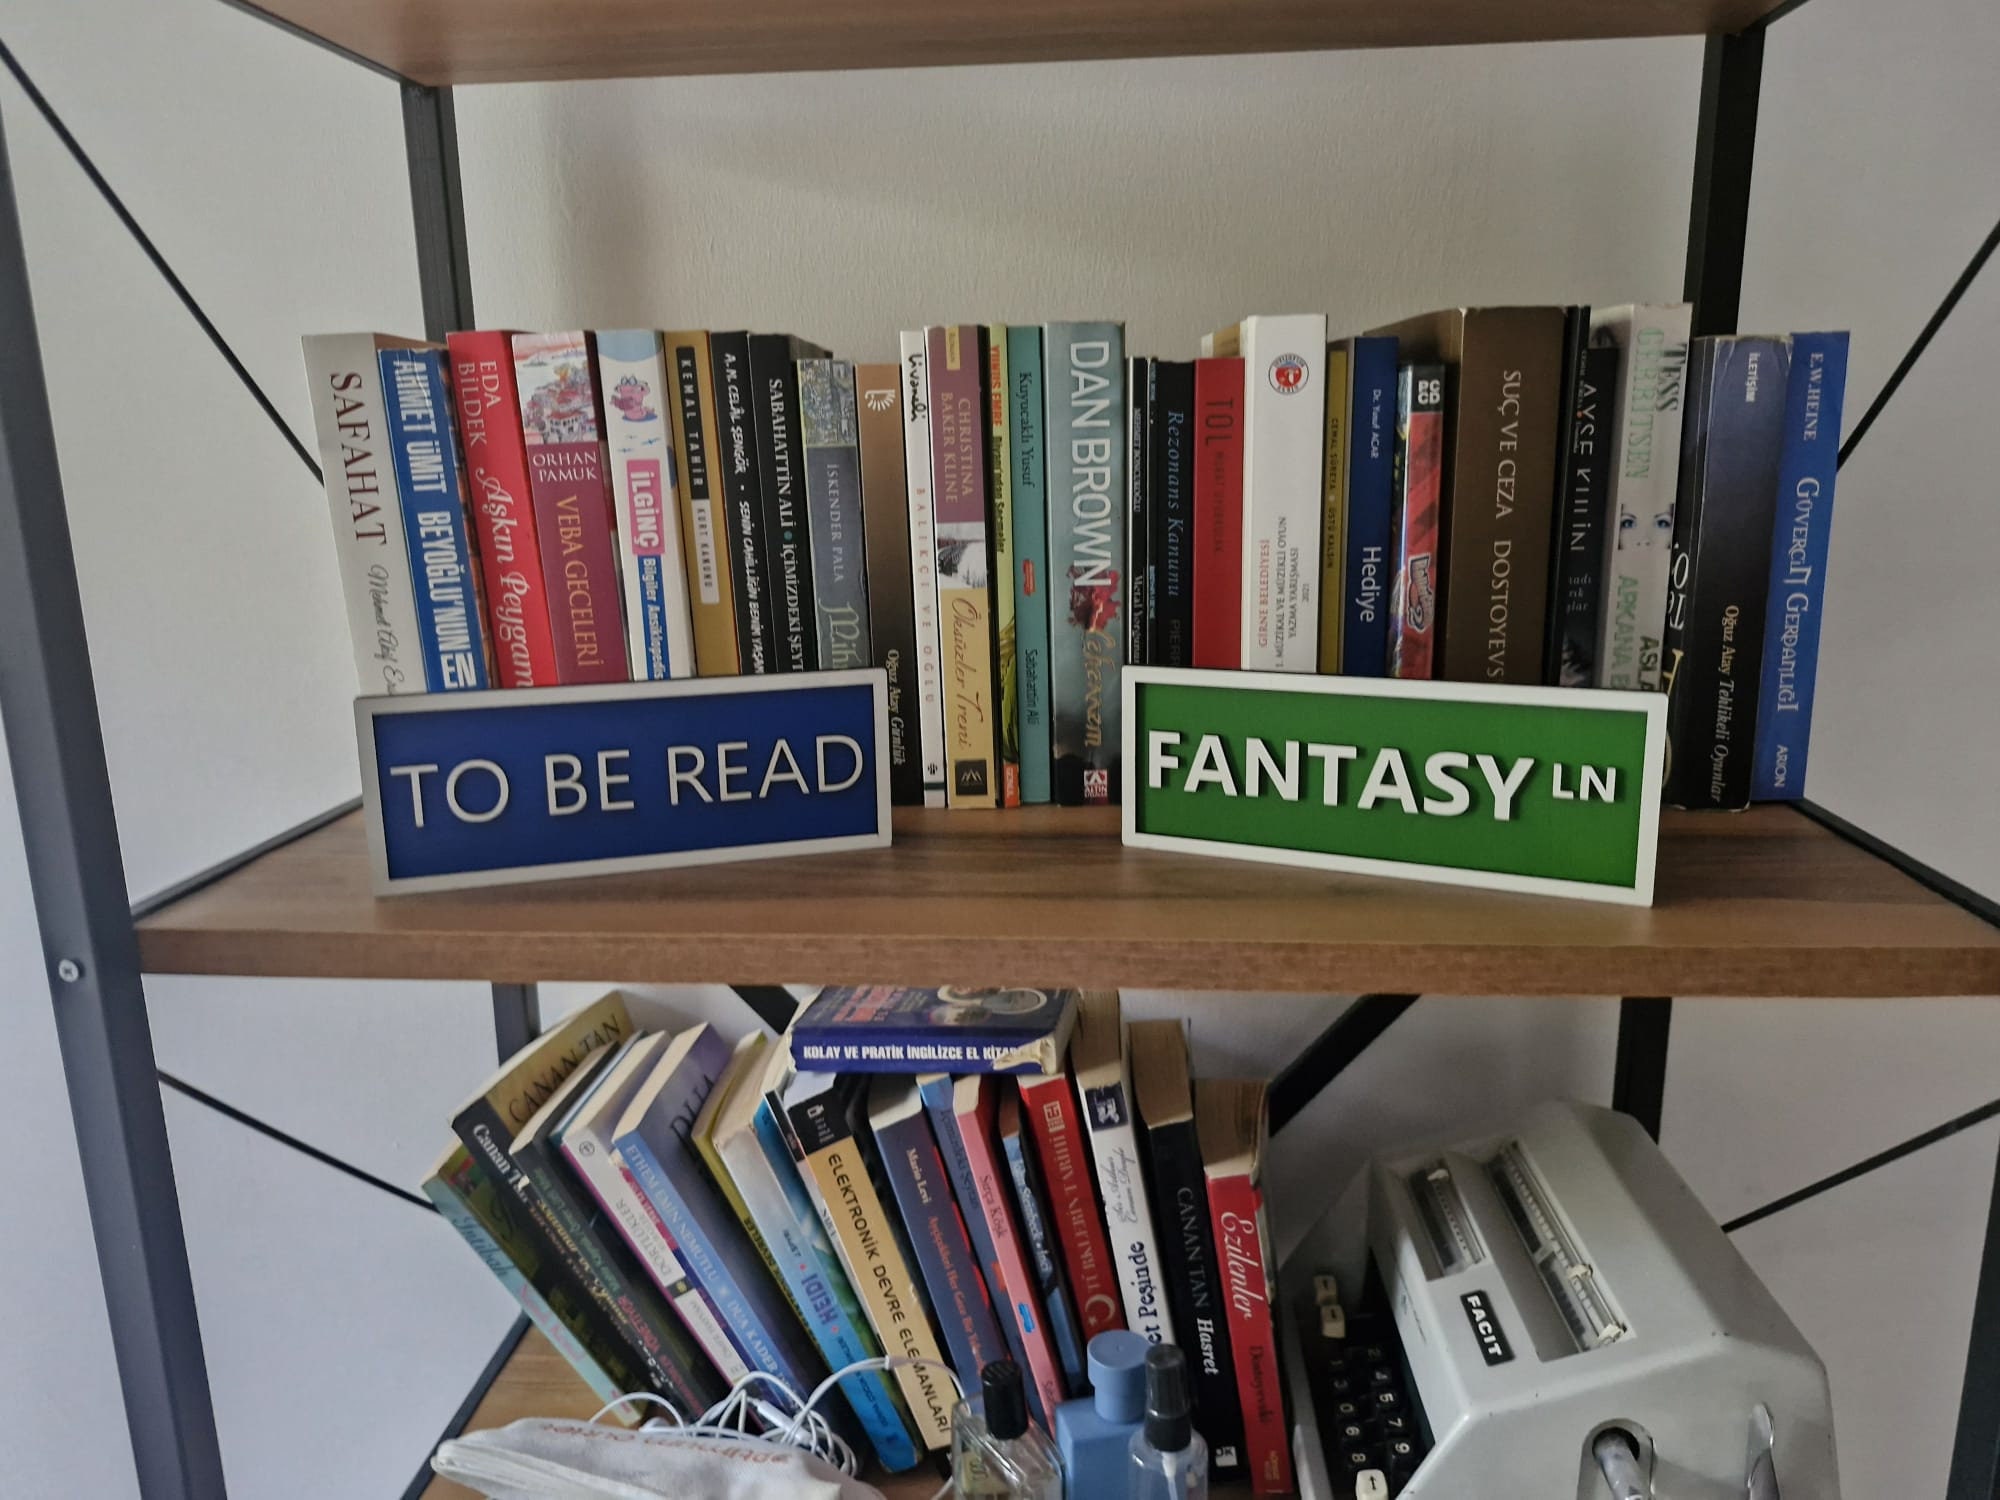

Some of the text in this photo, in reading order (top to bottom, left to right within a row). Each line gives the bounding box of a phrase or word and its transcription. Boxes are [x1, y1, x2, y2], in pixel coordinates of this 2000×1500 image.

[478, 359, 502, 407] EDA
[989, 344, 1002, 425] YUNUS EMRE
[1417, 391, 1441, 404] CD
[1418, 379, 1441, 392] PC
[1625, 329, 1662, 478] GERRITSEN
[1655, 342, 1687, 412] TESS
[329, 372, 386, 544] SAFAHAT
[393, 359, 447, 492] AHMET ÜMİT
[680, 358, 705, 486] KEMAL TAHİR
[767, 377, 795, 526] SABAHATTİN ALİ
[941, 391, 957, 502] BAKER KLINE
[956, 398, 973, 495] CHRISTINA
[1015, 372, 1035, 487] Kuyucaklı Yusuf
[1204, 397, 1234, 446] TOL
[1331, 418, 1339, 448] CEMAL
[1370, 431, 1379, 458] ACAR
[1494, 369, 1521, 519] SUÇ VE CEZA
[532, 452, 597, 466] ORHAN
[537, 468, 598, 482] PAMUK
[1070, 341, 1112, 585] DAN BROWN
[479, 467, 517, 562] Aşkın
[629, 470, 659, 547] İLGİNÇ
[696, 507, 709, 535] KURT
[737, 499, 753, 535] SENİN
[825, 463, 845, 583] İSKENDER PALA
[1167, 410, 1183, 596] Rezonans Kanunu
[1277, 516, 1287, 548] OYUN
[417, 509, 474, 651] BEYOĞLU'NUN
[555, 494, 600, 666] VEBA GECELERİ
[640, 557, 660, 602] Bilgiler
[779, 542, 801, 632] İÇİMİZDEKİ
[914, 487, 934, 704] BALIKÇI VE OĞLU
[1257, 538, 1270, 647] GİRNE BELEDİYESİ
[1275, 597, 1285, 610] VE
[1286, 547, 1300, 638] YAZMA YARIŞMASI
[1355, 545, 1382, 622] Hediye
[439, 652, 477, 690] EN
[884, 648, 900, 683] Oğuz
[1273, 612, 1284, 658] MÜZİKAL
[1719, 604, 1739, 674] Oğuz Atay
[950, 596, 983, 748] Öksüzler Treni
[1024, 648, 1039, 724] Sabahattin Ali
[889, 715, 906, 765] Günlük
[1148, 730, 1617, 821] FANTASY LN
[1709, 679, 1735, 801] Tehlikeli Oyunlar
[1773, 743, 1789, 786] ARION
[390, 735, 864, 828] TO BE READ
[579, 1014, 622, 1054] TAN
[803, 1044, 980, 1060] KOLAY VE PRATİK İNGİLİZCE EL
[472, 1123, 511, 1174] Canan
[623, 1142, 660, 1189] ETHEM
[906, 1147, 932, 1204] Mario Levi
[827, 1152, 879, 1260] ELEKTRONİK
[873, 1265, 905, 1323] DEVRE
[988, 1205, 1008, 1239] Köşk
[1017, 1186, 1042, 1241] Steinbeck
[1176, 1185, 1209, 1308] CANAN TAN
[800, 1273, 839, 1325] HEIDI
[1127, 1240, 1158, 1318] Peşinde
[1219, 1210, 1263, 1318] Ezilenler
[743, 1327, 779, 1373] KADER
[1195, 1317, 1219, 1375] Hasret
[1467, 1295, 1502, 1356] FACIT
